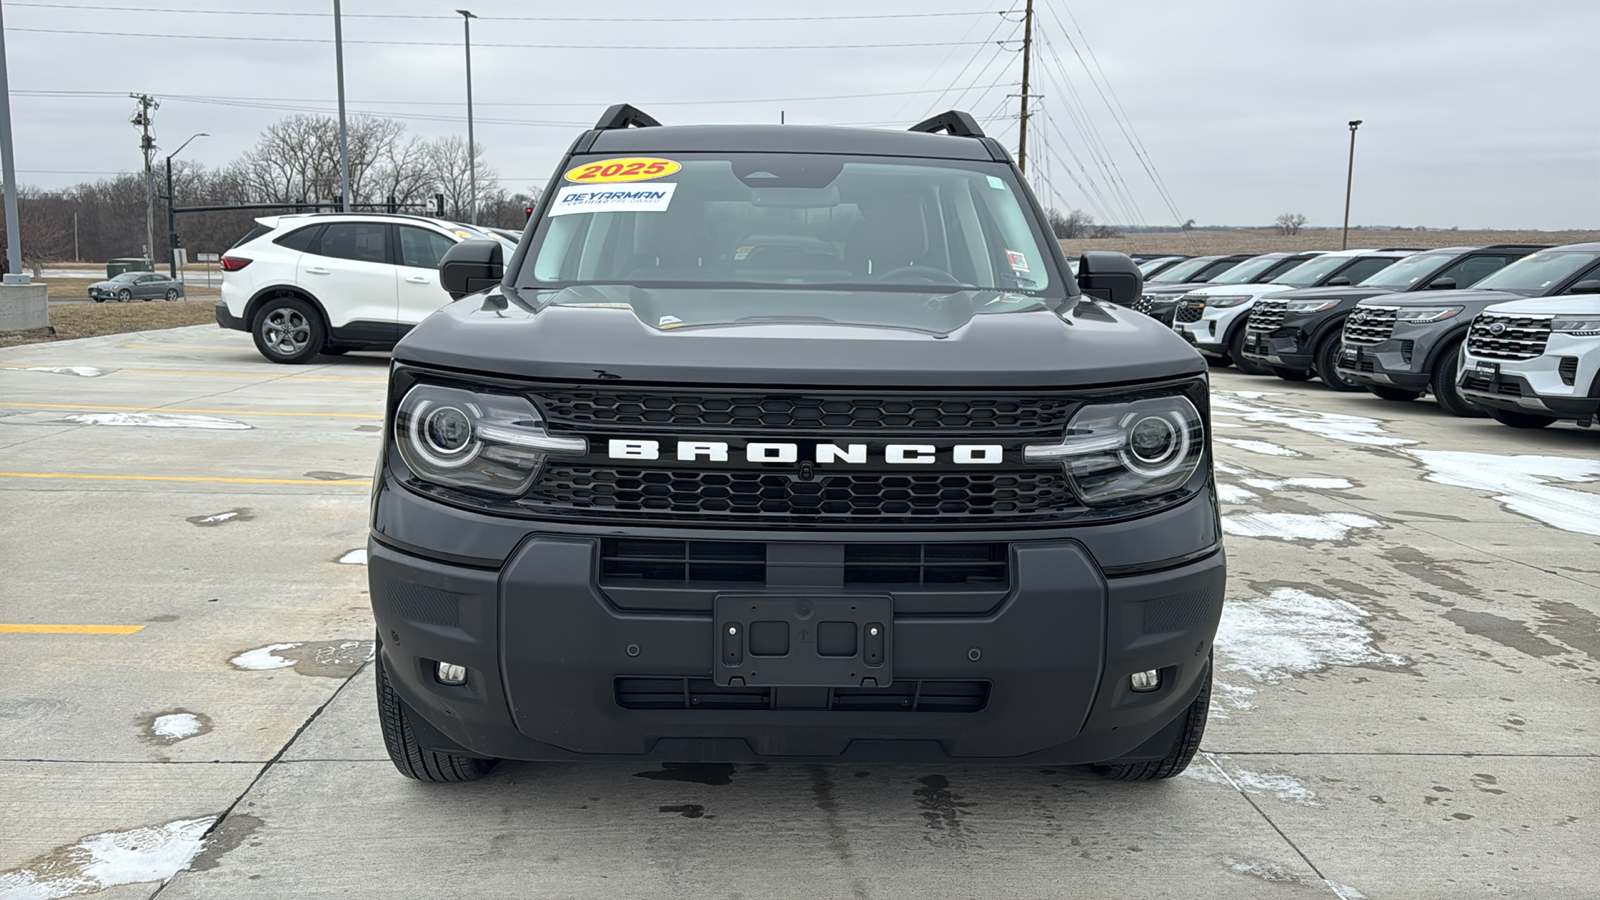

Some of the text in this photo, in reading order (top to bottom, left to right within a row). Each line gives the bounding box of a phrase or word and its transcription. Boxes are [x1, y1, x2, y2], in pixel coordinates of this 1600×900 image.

[576, 162, 669, 180] 2025
[562, 191, 667, 203] DEYARMAN
[608, 439, 1003, 464] BRONCO
